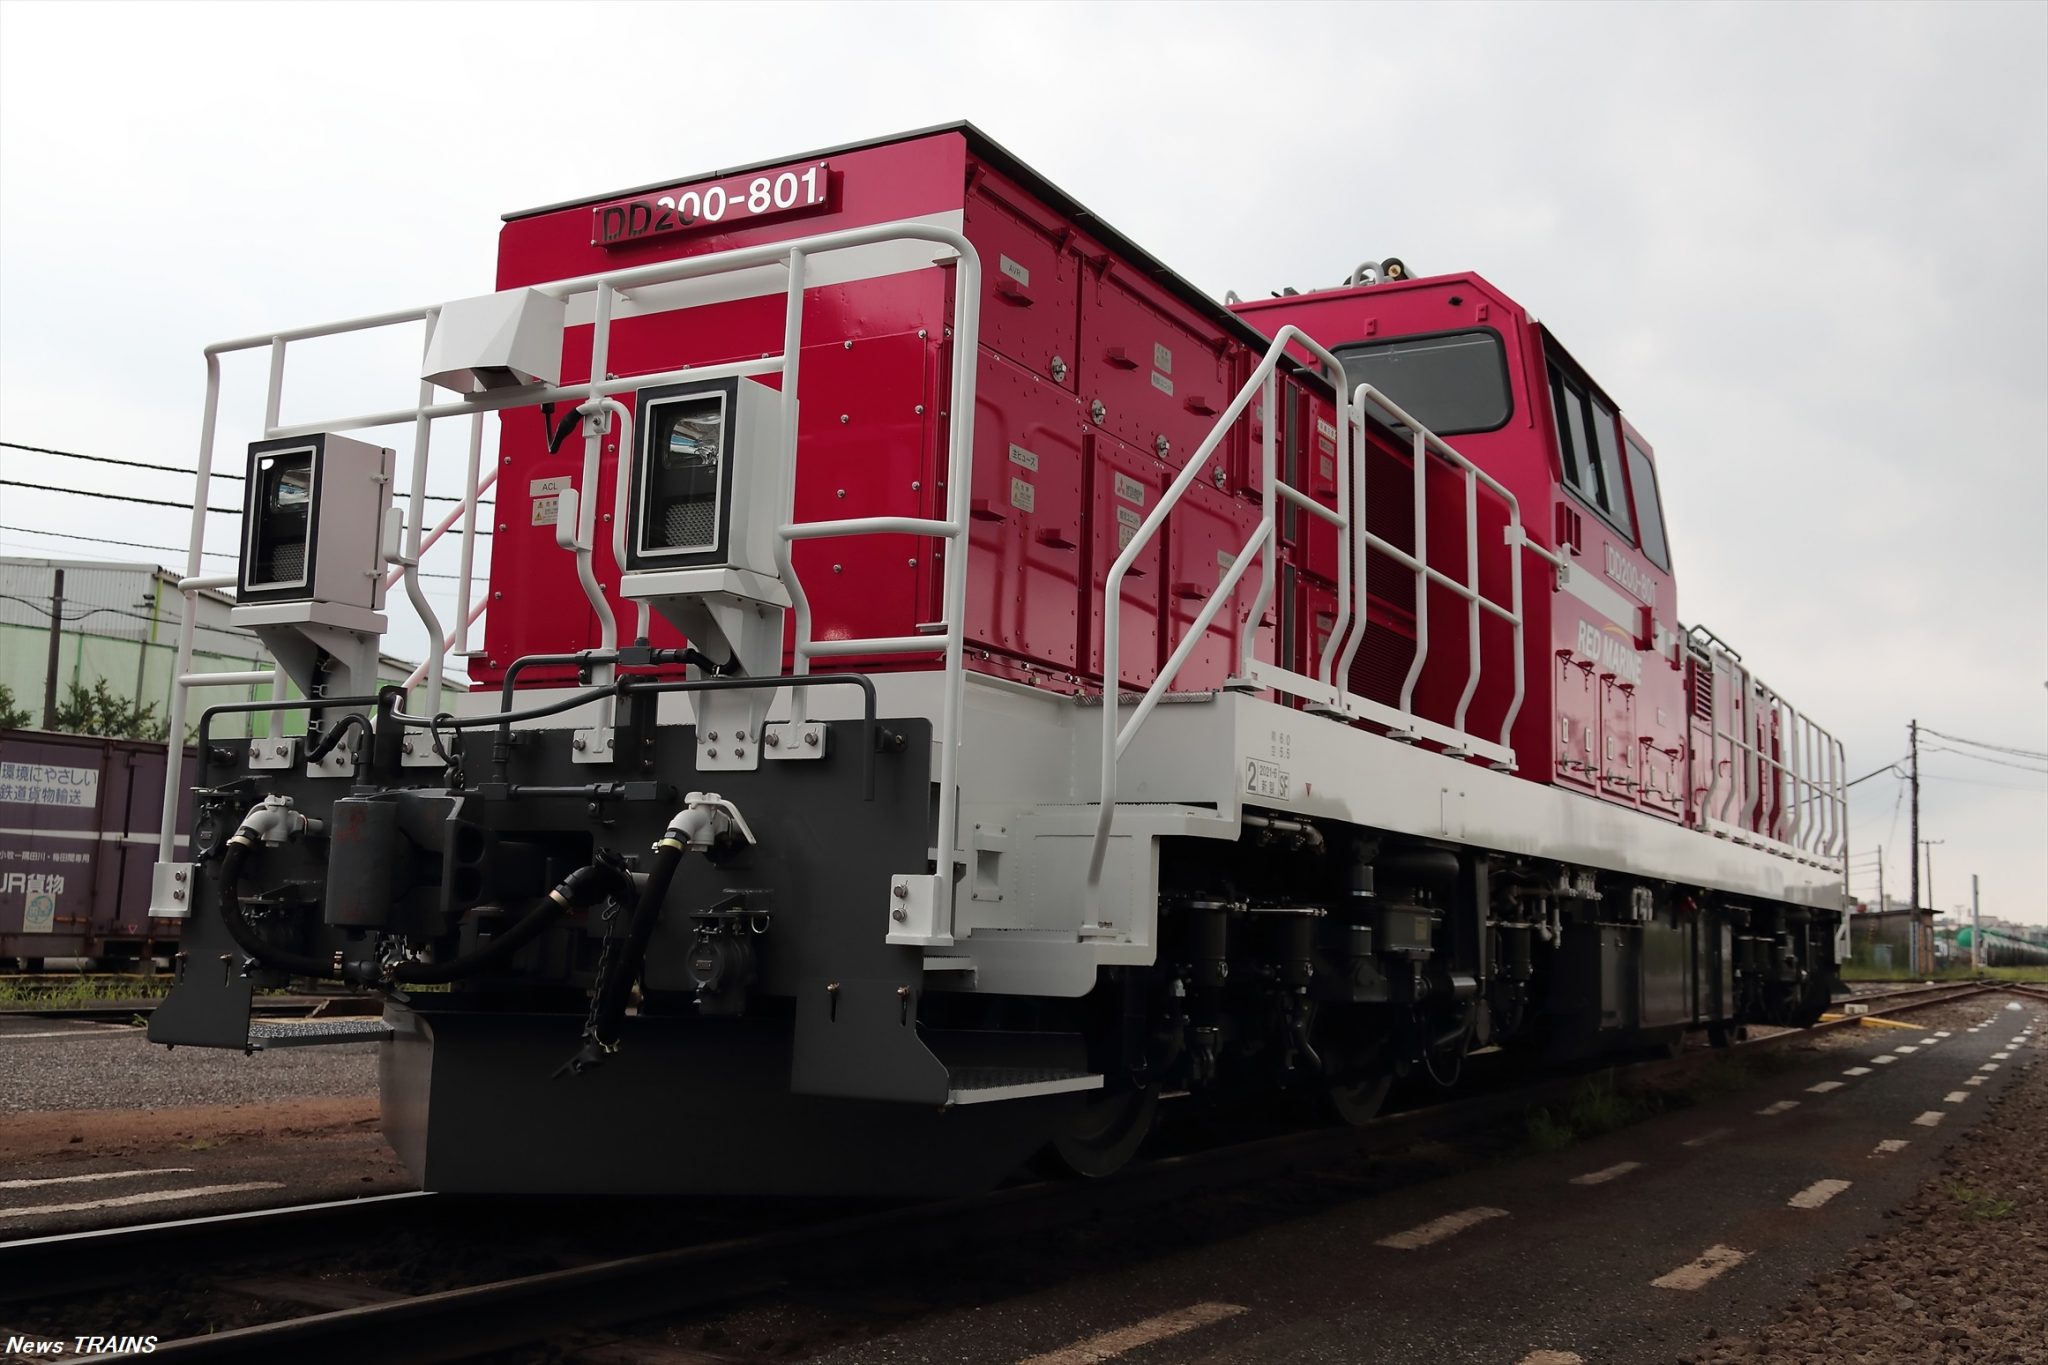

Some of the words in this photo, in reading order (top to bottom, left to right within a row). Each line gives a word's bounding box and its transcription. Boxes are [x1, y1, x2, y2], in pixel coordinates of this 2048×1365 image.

[603, 167, 817, 241] DD200-801
[542, 482, 557, 491] ACL
[1577, 619, 1601, 661] RED
[1602, 635, 1642, 686] MARINE
[2, 763, 97, 786] 環境にやさしい
[1248, 761, 1257, 791] 2
[0, 783, 81, 805] 鉄道貨物輸送
[0, 872, 65, 897] JR貨物
